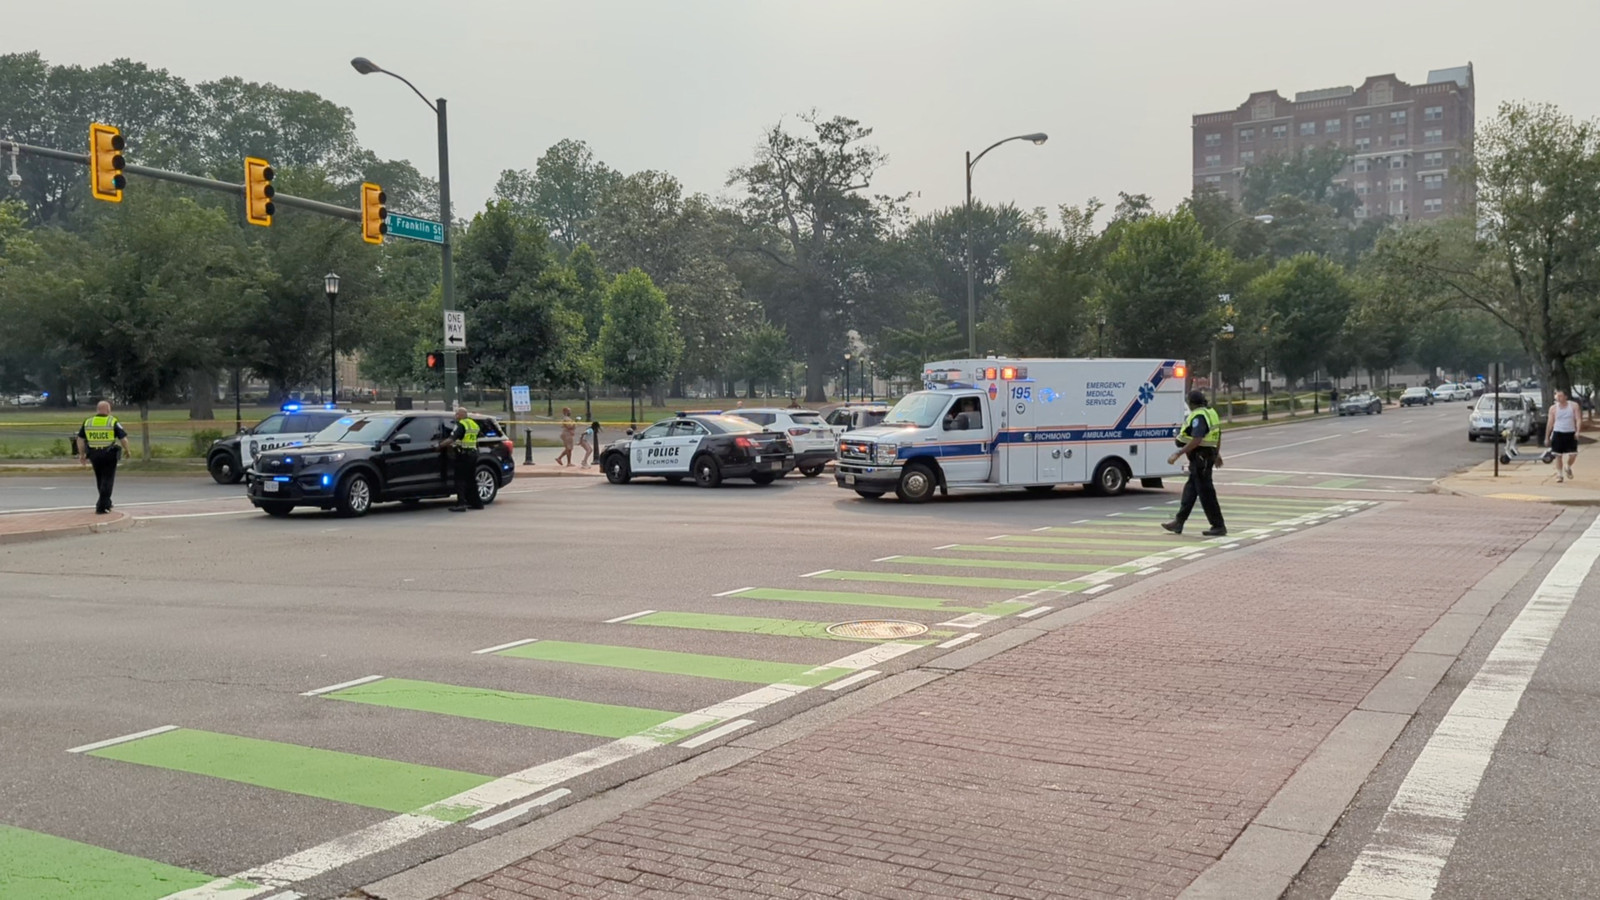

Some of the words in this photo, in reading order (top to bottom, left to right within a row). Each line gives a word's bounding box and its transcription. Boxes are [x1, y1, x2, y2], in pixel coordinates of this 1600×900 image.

[396, 217, 430, 233] Franklin
[432, 224, 442, 235] St
[447, 313, 462, 323] ONE
[447, 323, 462, 333] WAY
[1086, 381, 1126, 390] EMERGENCY
[1010, 386, 1031, 400] 195
[1086, 390, 1115, 398] MEDICAL
[1085, 398, 1117, 406] SERVICES
[89, 431, 109, 440] POLICE
[1034, 432, 1071, 441] RICHMOND
[1082, 430, 1123, 439] AMBULANCE
[1133, 429, 1169, 438] AUTHORITY
[647, 446, 680, 457] POLICE
